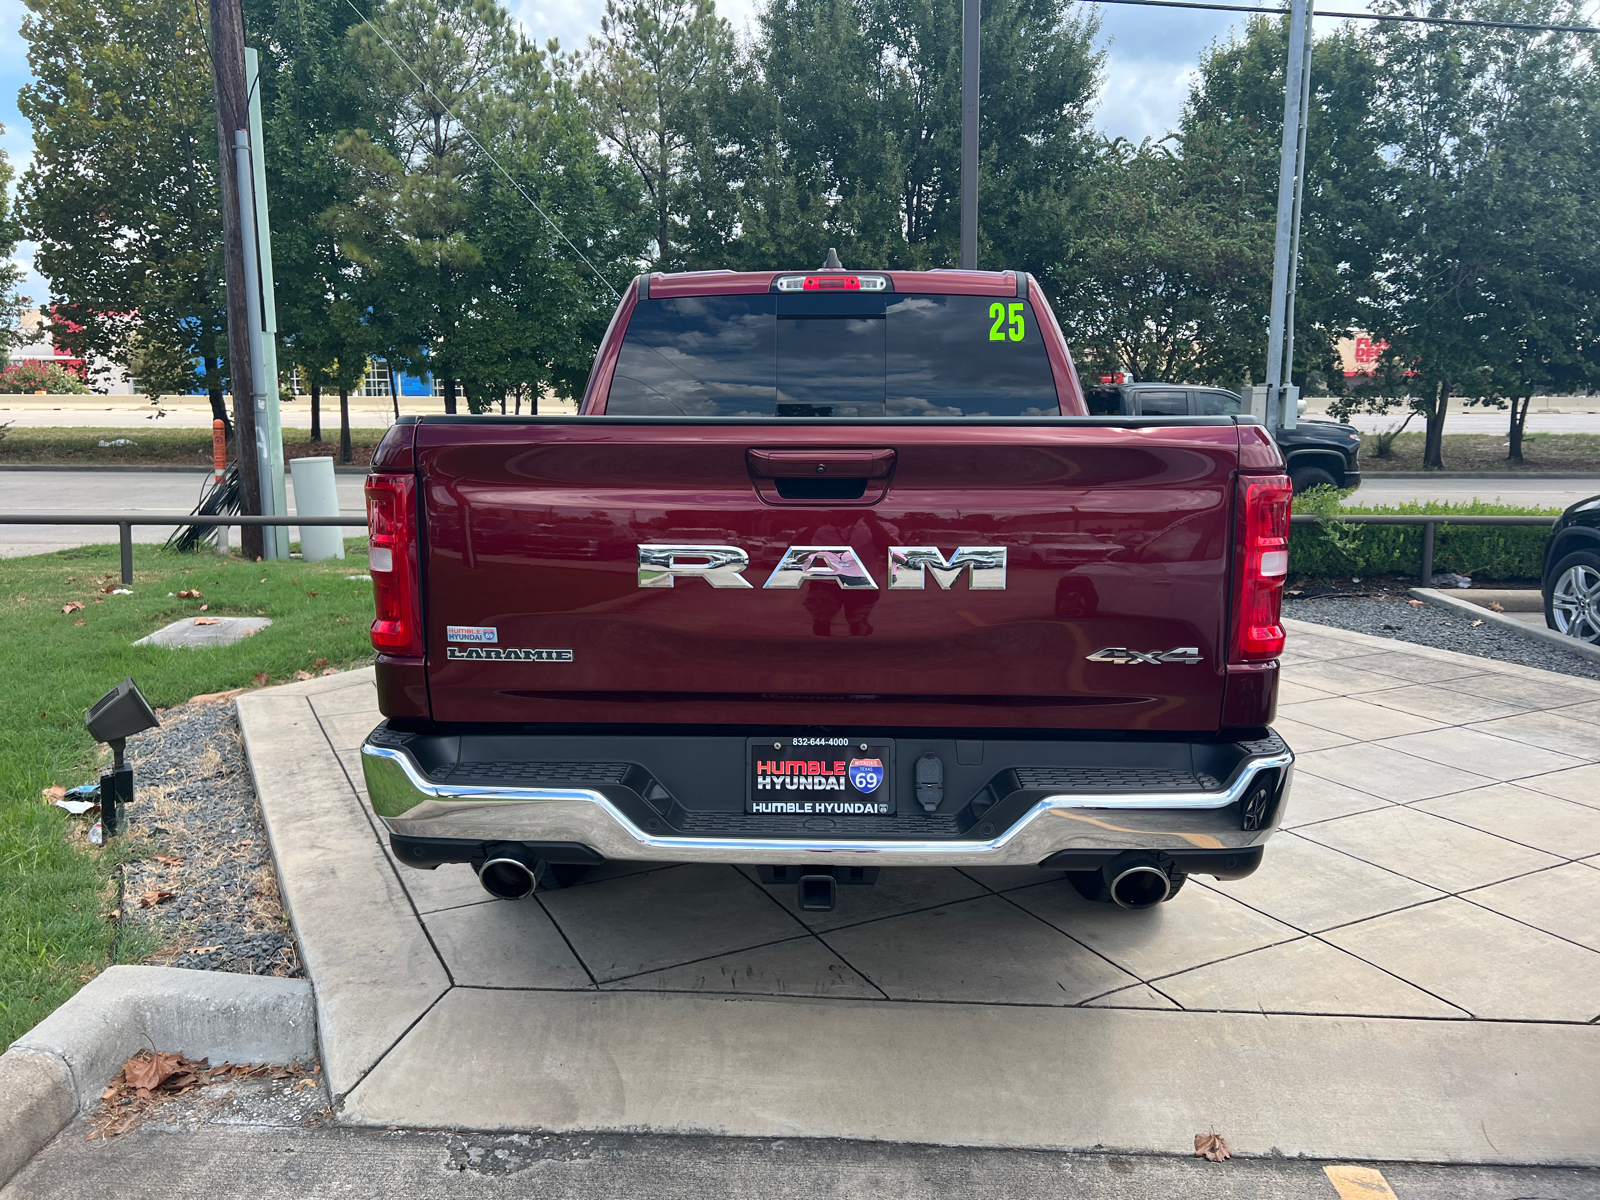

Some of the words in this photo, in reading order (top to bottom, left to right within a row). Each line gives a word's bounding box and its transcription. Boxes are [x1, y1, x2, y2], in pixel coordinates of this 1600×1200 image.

[989, 302, 1025, 342] 25
[637, 544, 1008, 590] RAM
[446, 647, 573, 662] LARAMIE
[792, 738, 849, 746] 832-644-4000
[757, 760, 846, 775] HUMBLE
[757, 776, 846, 790] HYUNDAI
[855, 772, 877, 788] 69
[753, 803, 813, 813] HUMBLE
[815, 803, 878, 814] HYUNDAI
